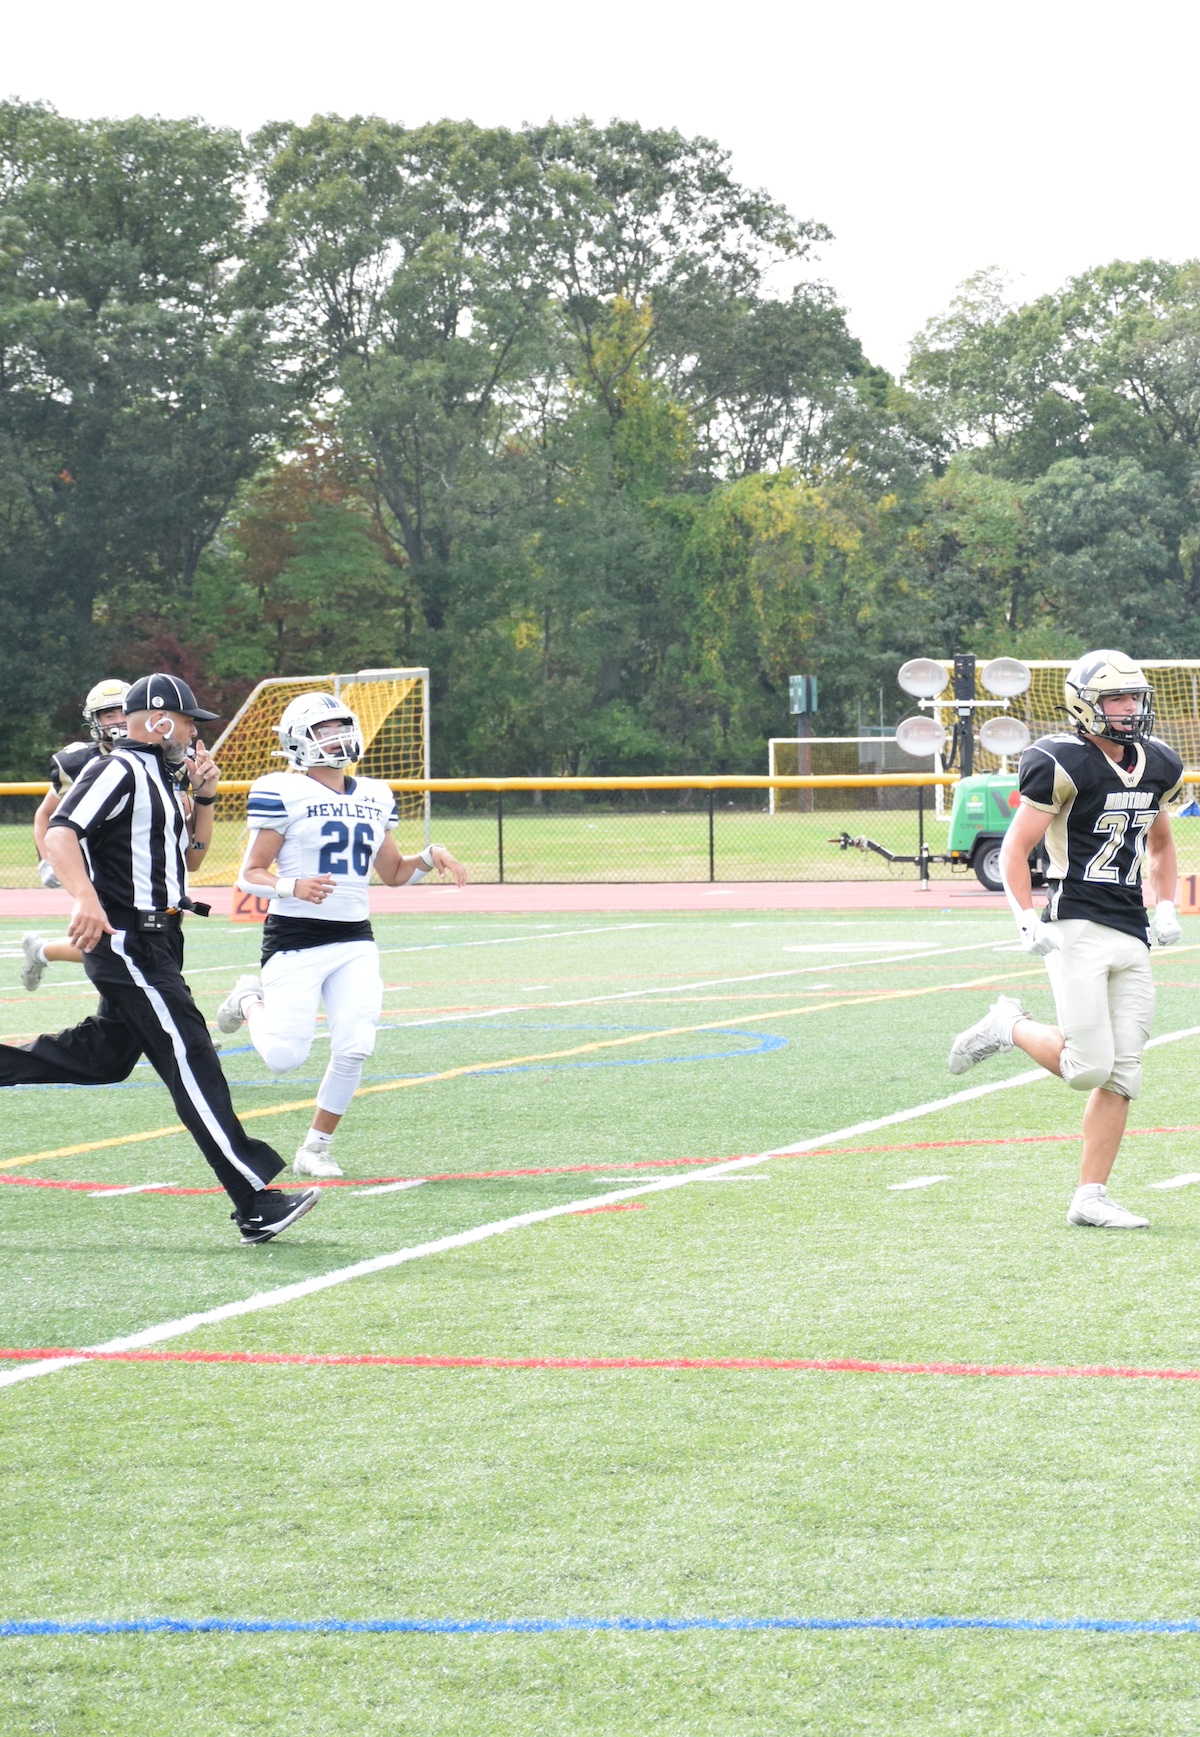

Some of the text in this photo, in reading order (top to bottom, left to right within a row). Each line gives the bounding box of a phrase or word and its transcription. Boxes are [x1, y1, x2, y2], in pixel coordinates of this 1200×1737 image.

[306, 803, 382, 821] HEWLETT
[318, 820, 375, 876] 26
[1083, 810, 1159, 885] 27
